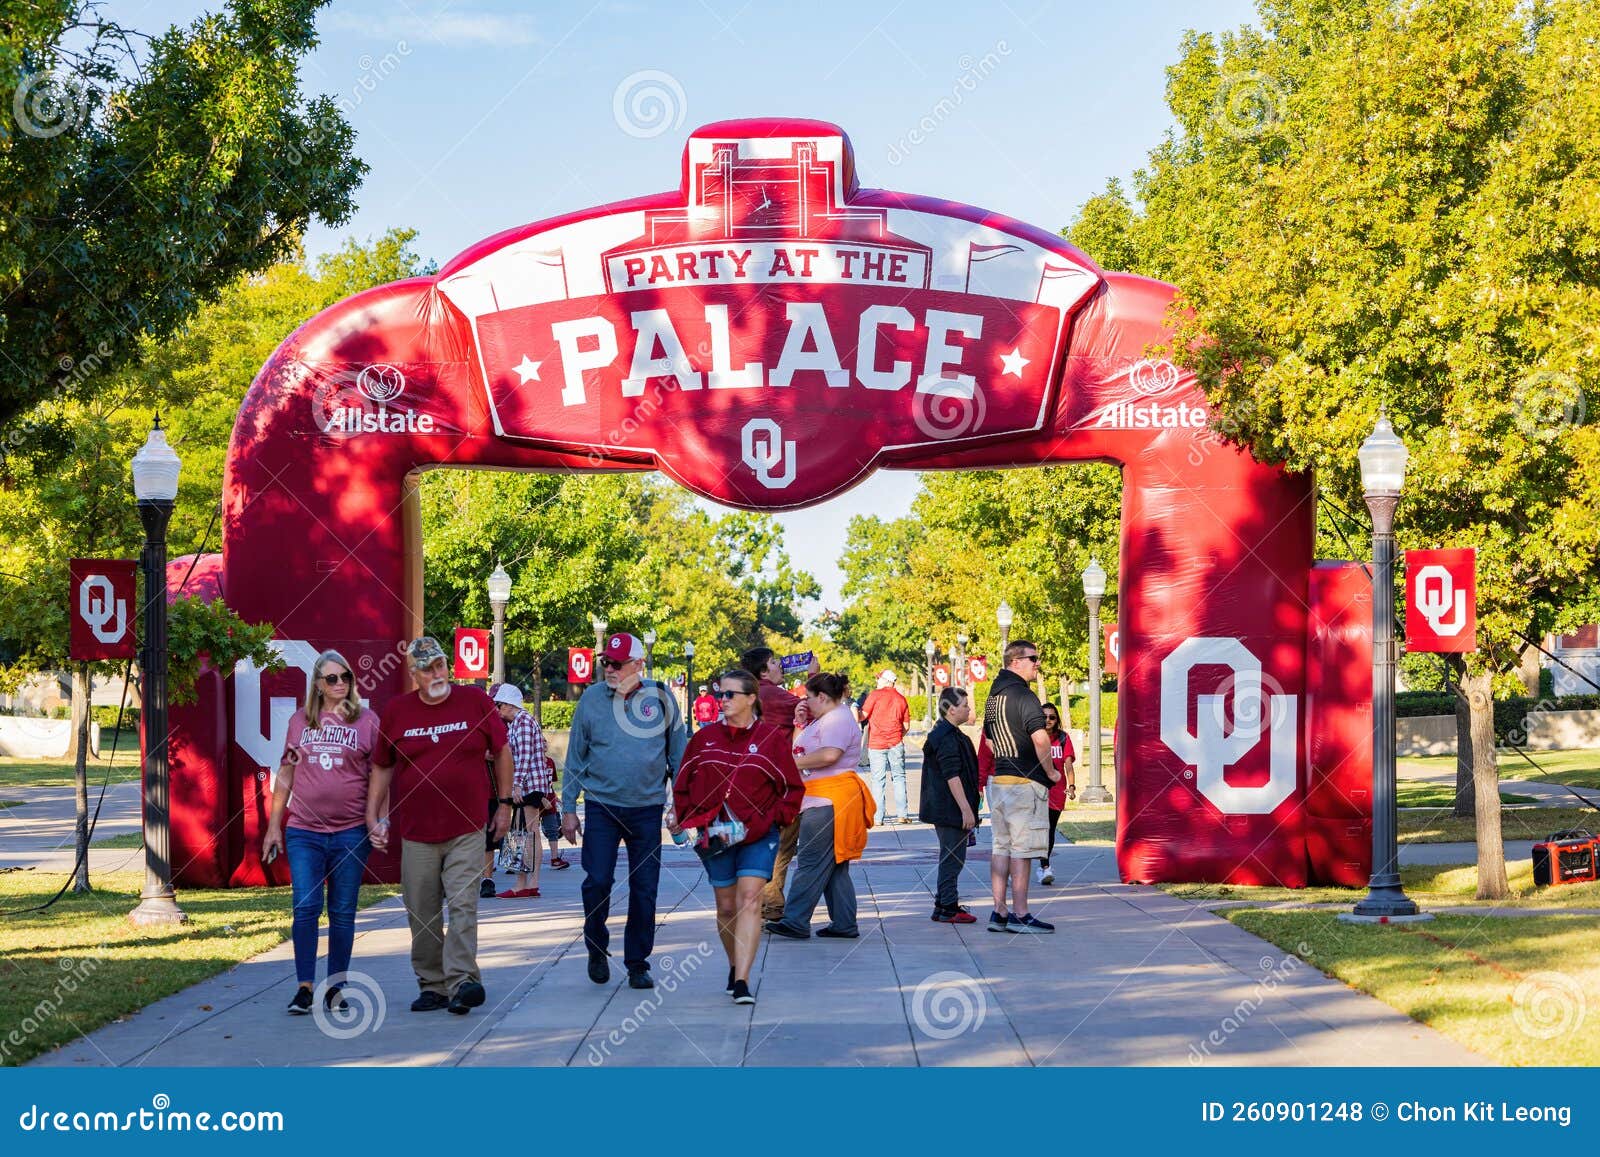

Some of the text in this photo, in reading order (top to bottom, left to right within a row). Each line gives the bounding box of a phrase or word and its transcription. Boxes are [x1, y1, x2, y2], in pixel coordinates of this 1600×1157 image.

[624, 248, 909, 287] PARTY AT THE
[551, 302, 984, 407] PALACE
[323, 407, 435, 433] Allstate
[1094, 401, 1206, 429] Allstate
[742, 418, 796, 489] OU
[79, 574, 127, 643] OU
[1415, 565, 1466, 636] OU
[459, 636, 485, 671] OU
[571, 653, 590, 678] OU
[300, 724, 358, 751] OKLAHOMA
[403, 721, 468, 737] OKLAHOMA
[1160, 637, 1298, 814] OU
